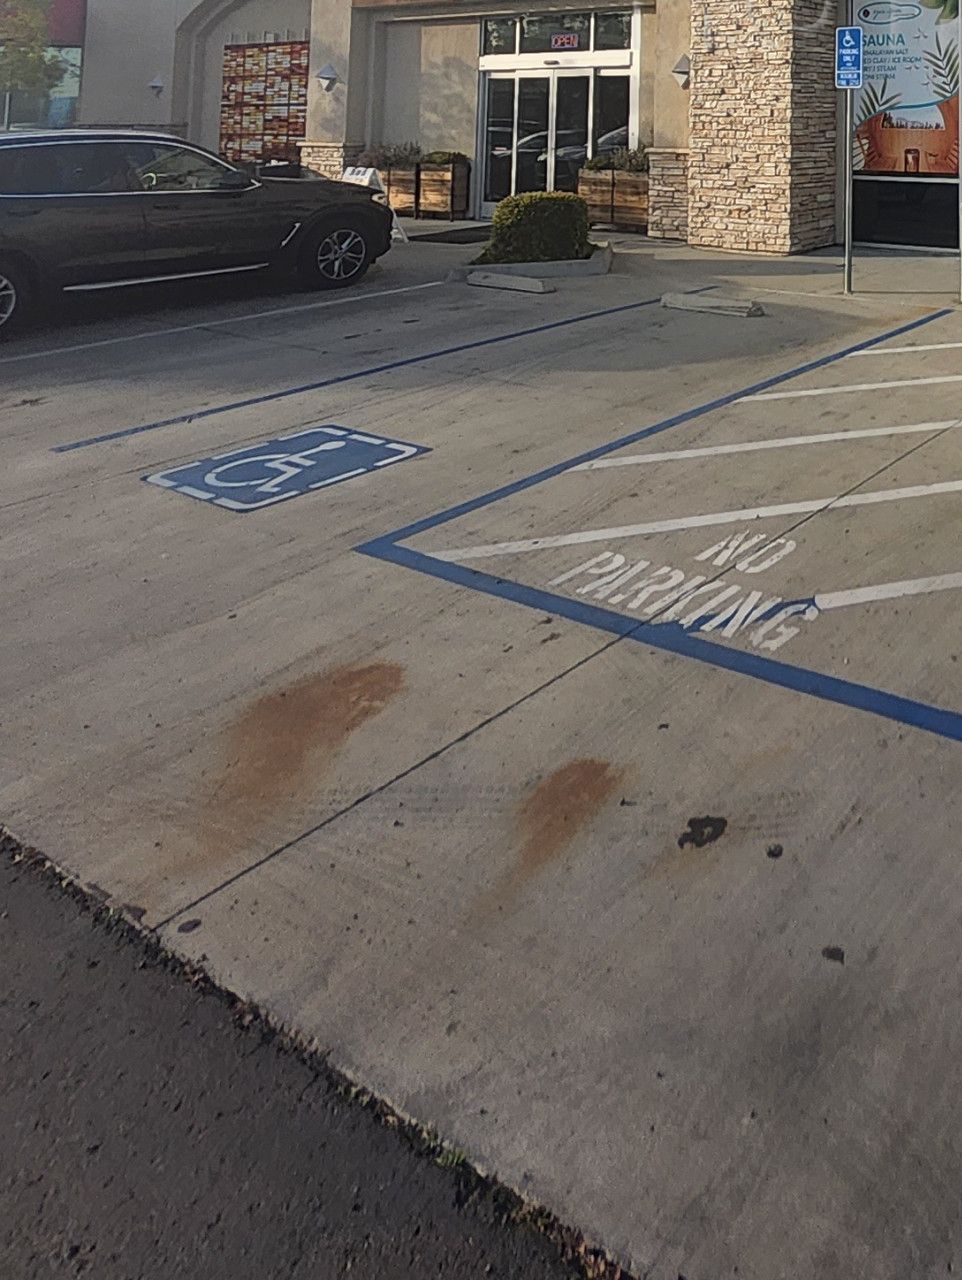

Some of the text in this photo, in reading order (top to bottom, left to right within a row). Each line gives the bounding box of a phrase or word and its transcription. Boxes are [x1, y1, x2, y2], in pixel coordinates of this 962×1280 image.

[862, 33, 905, 46] SAUNA
[694, 529, 797, 573] NO
[549, 551, 820, 651] PARKING
